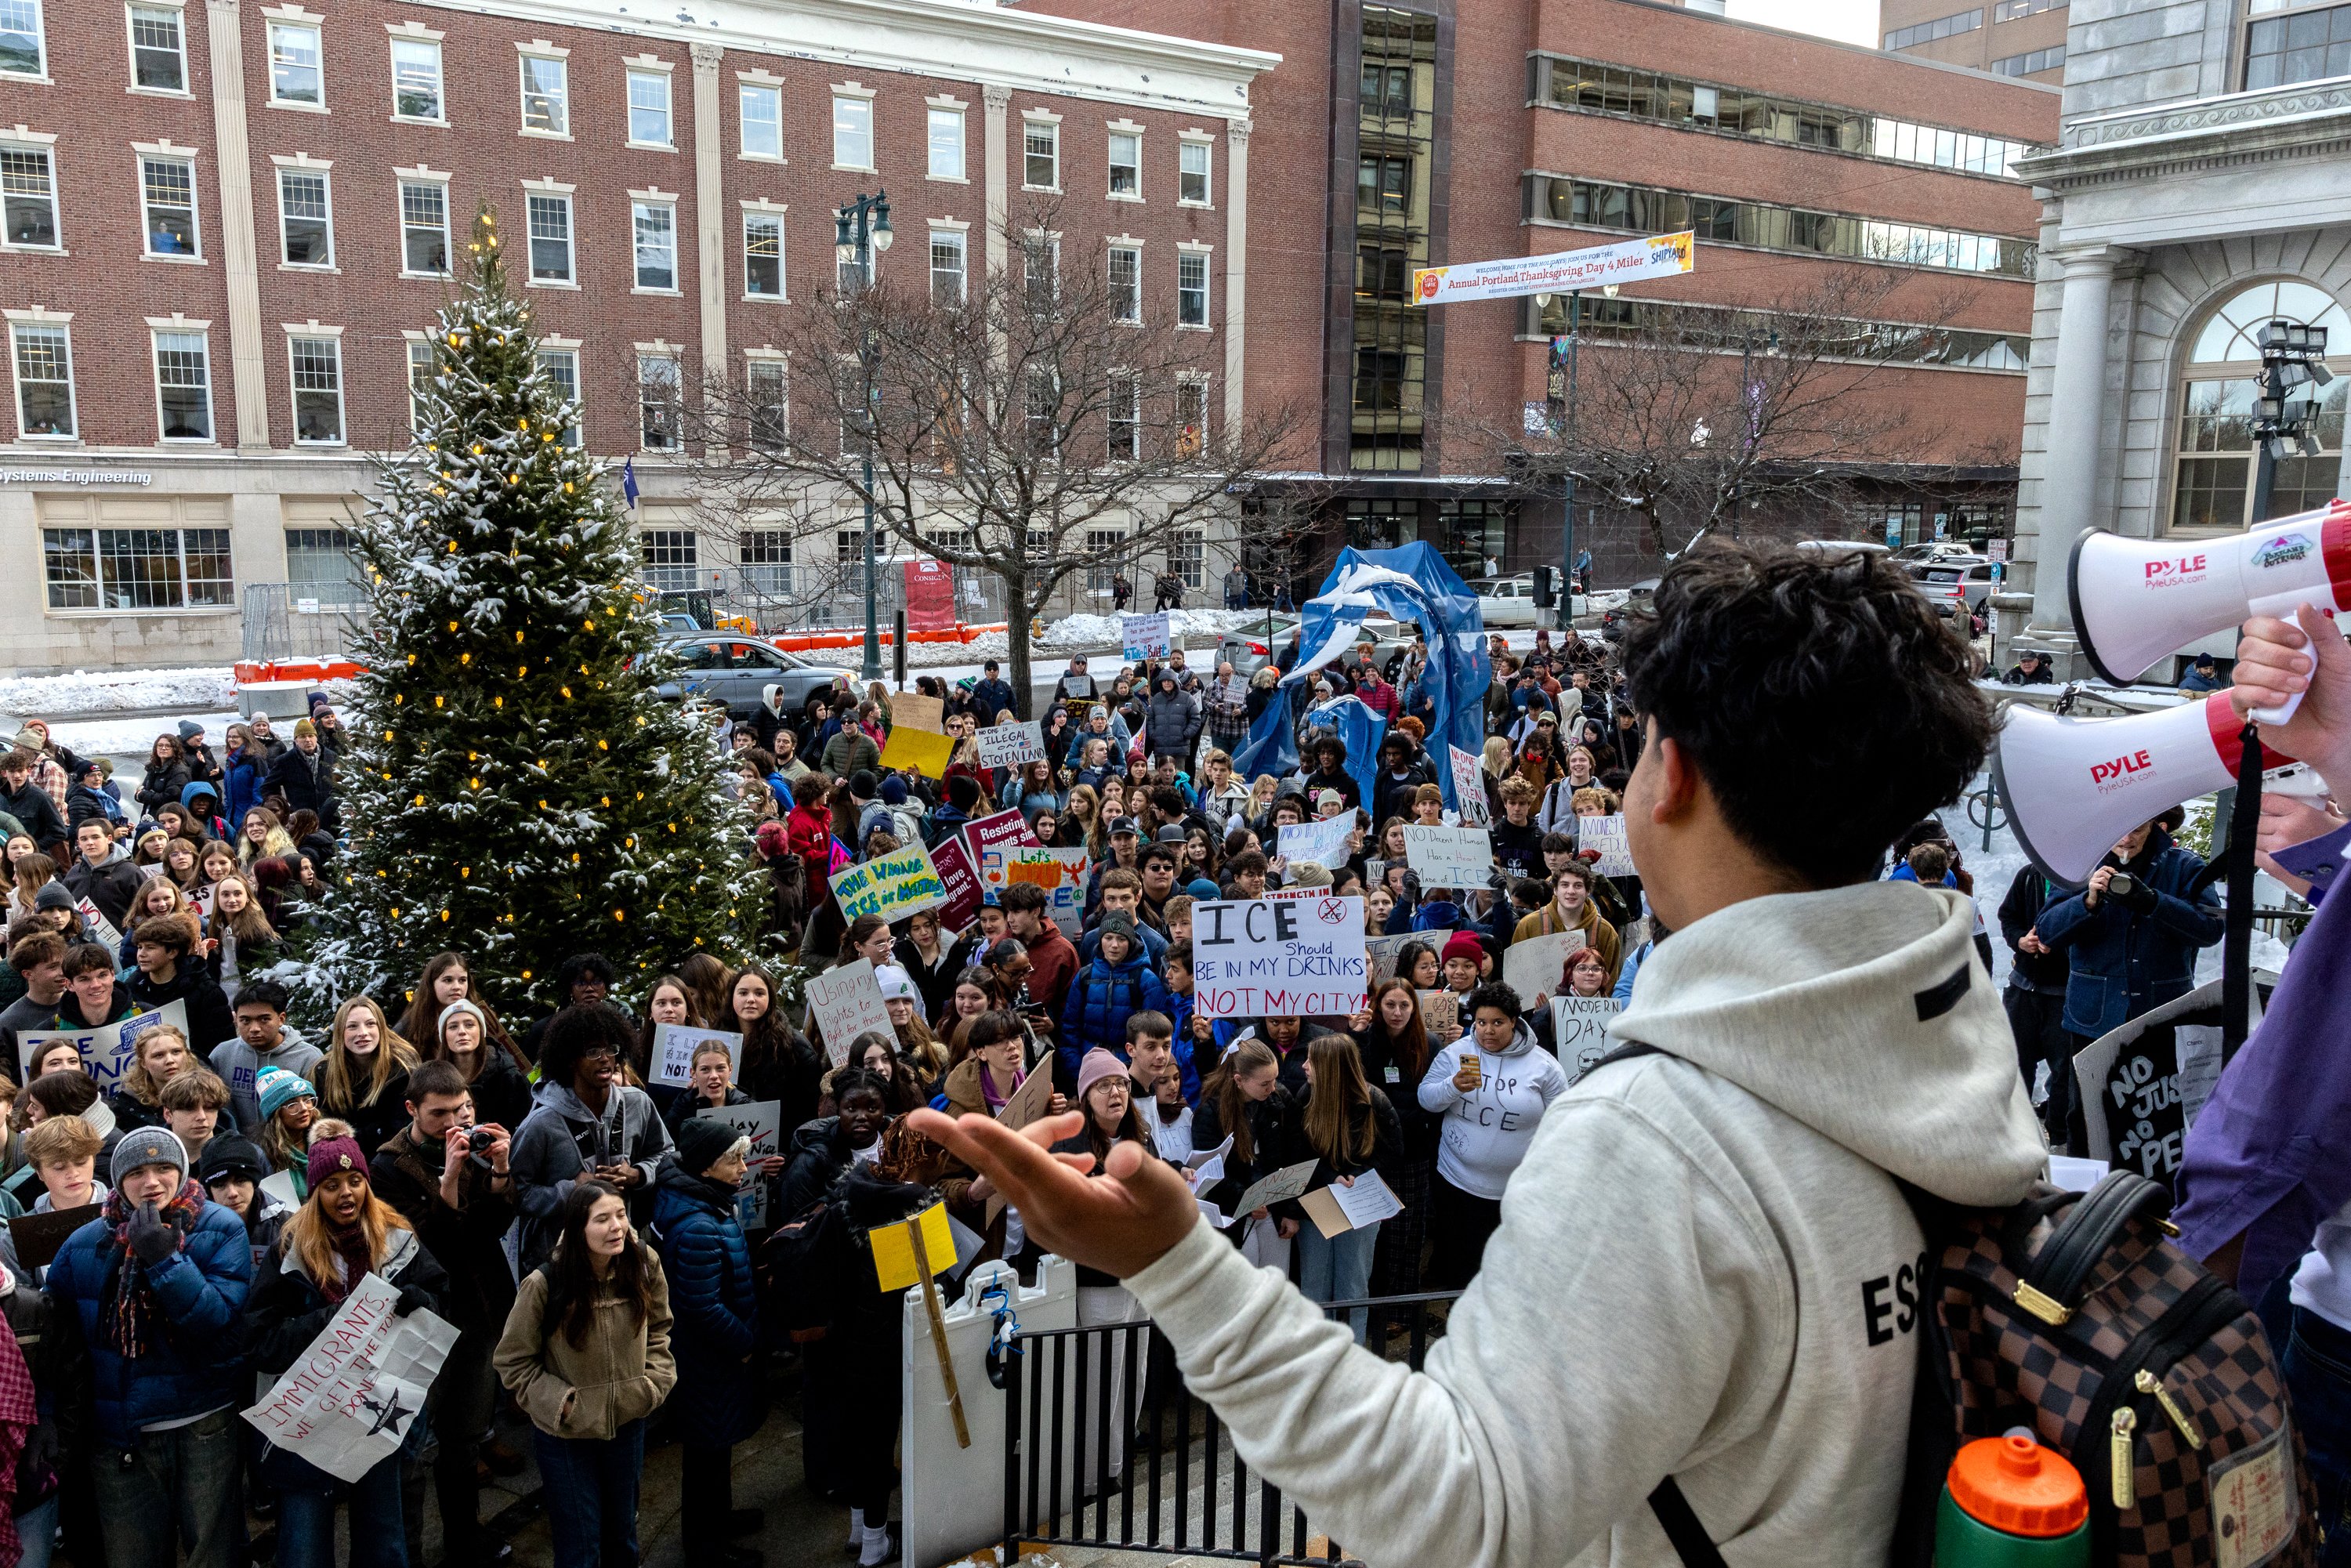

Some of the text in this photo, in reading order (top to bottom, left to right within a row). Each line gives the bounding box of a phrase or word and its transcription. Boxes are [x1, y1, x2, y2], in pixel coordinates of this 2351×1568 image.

[1651, 246, 1686, 264] SHIPYARD
[1448, 255, 1644, 288] Annual Portland Thanksgiving Day 4 Miler
[62, 469, 152, 486] Engineering
[2145, 554, 2207, 578] PYLE
[2264, 552, 2306, 567] OUTRIGHT
[2145, 574, 2207, 590] PyleUSA.com
[984, 730, 1029, 746] ILLEGAL
[998, 741, 1017, 751] ON
[981, 748, 1045, 766] STOLEN LAND
[1451, 748, 1476, 766] NO ONE
[2090, 749, 2152, 784] PYLE
[1456, 781, 1483, 802] STOLEN
[980, 818, 1027, 841] Resisting
[1279, 825, 1302, 842] NO
[1404, 826, 1486, 846] NO Decent Human
[1582, 817, 1617, 837] MONEY
[1581, 839, 1599, 849] AND
[1020, 849, 1051, 864] Let's
[1426, 849, 1443, 860] Has
[1455, 849, 1477, 863] Heart
[944, 867, 965, 888] love
[1371, 864, 1384, 878] NO
[1440, 867, 1488, 885] of ICE
[188, 887, 210, 901] IS
[835, 869, 870, 898] THE
[1265, 887, 1329, 900] STRENGTH IN
[78, 899, 101, 926] NO
[844, 891, 882, 919] ICE
[1198, 901, 1299, 946] ICE
[1285, 941, 1333, 956] Should
[1196, 961, 1217, 981] BE
[1225, 961, 1241, 979] IN
[1250, 957, 1279, 976] MY
[1288, 956, 1364, 977] DRINKS
[810, 973, 872, 1006] Using my
[1197, 987, 1368, 1016] NOT MY CITY!
[1561, 998, 1619, 1019] MODERN
[822, 998, 871, 1031] Rights to
[668, 1034, 677, 1045] I
[827, 1012, 885, 1047] fight for those
[1564, 1018, 1607, 1048] DAY
[665, 1063, 687, 1077] NOT
[1482, 1073, 1517, 1095] TOP
[2110, 1056, 2154, 1109] NO
[2132, 1073, 2183, 1119] JUS
[1457, 1096, 1520, 1132] ICE
[2119, 1120, 2155, 1161] NO
[2141, 1128, 2186, 1179] PE
[283, 1414, 317, 1440] WE
[319, 1377, 350, 1413] GET
[349, 1338, 379, 1371] THE
